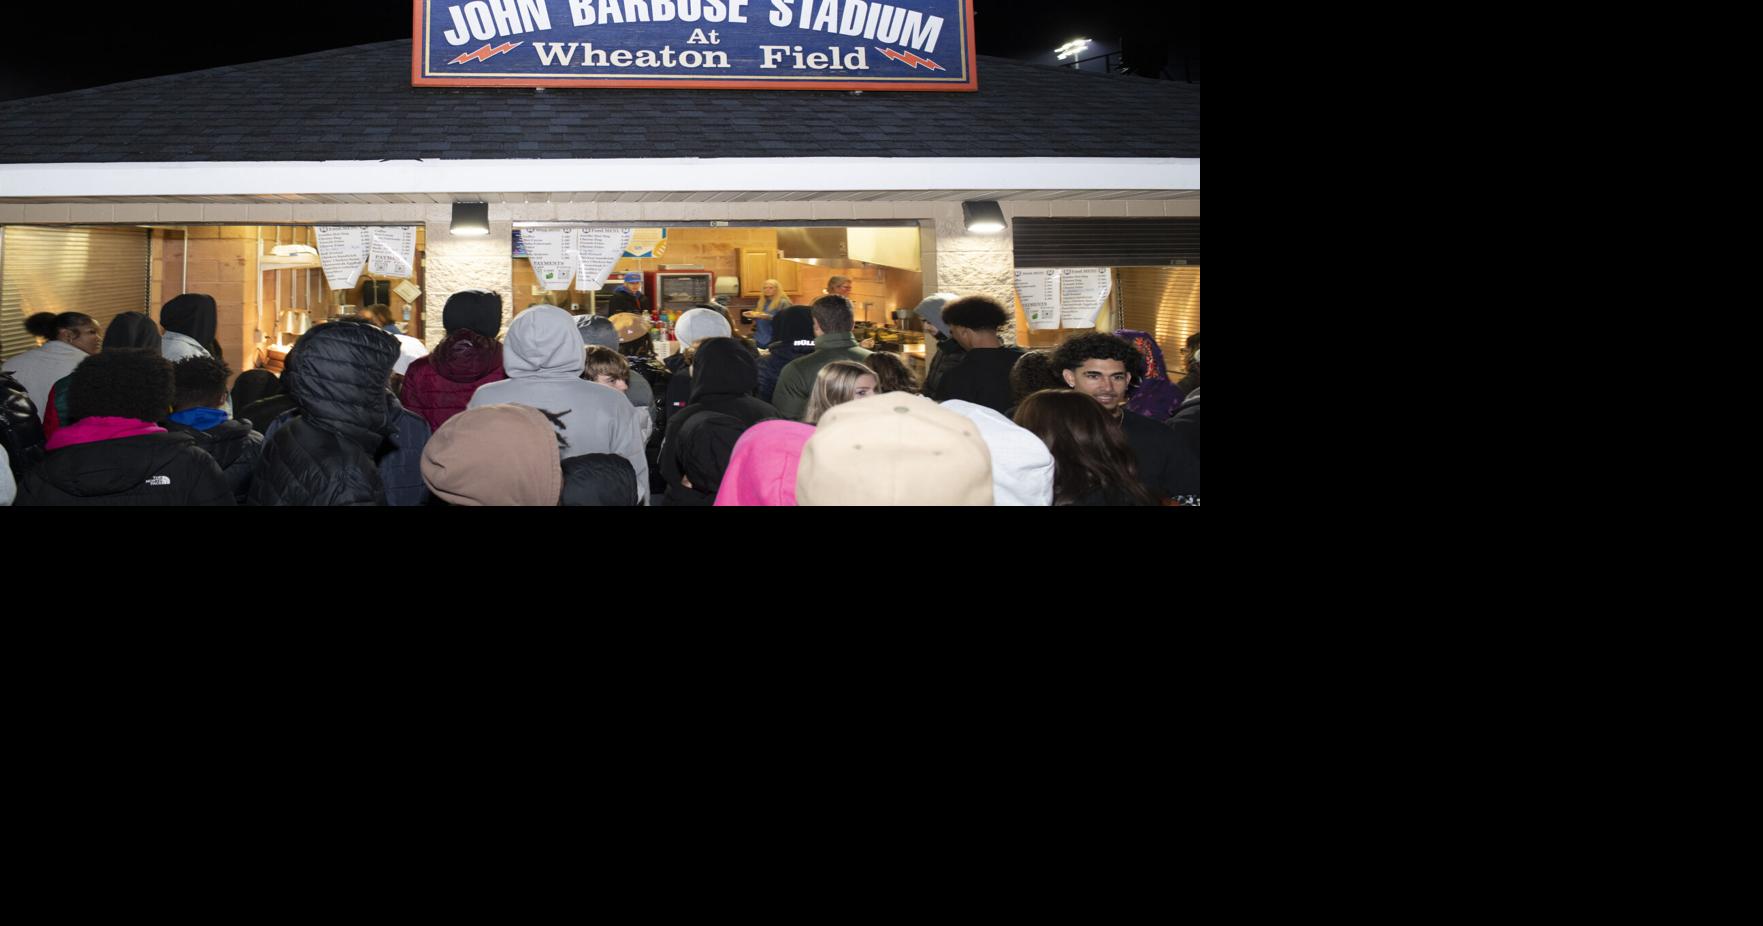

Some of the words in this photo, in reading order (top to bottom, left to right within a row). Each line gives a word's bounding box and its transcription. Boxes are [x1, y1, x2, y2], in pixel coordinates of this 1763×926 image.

[443, 0, 551, 46] JOHN
[769, 0, 944, 53] STADIUM
[687, 28, 720, 45] At
[533, 42, 731, 69] Wheaton
[759, 45, 869, 70] Field
